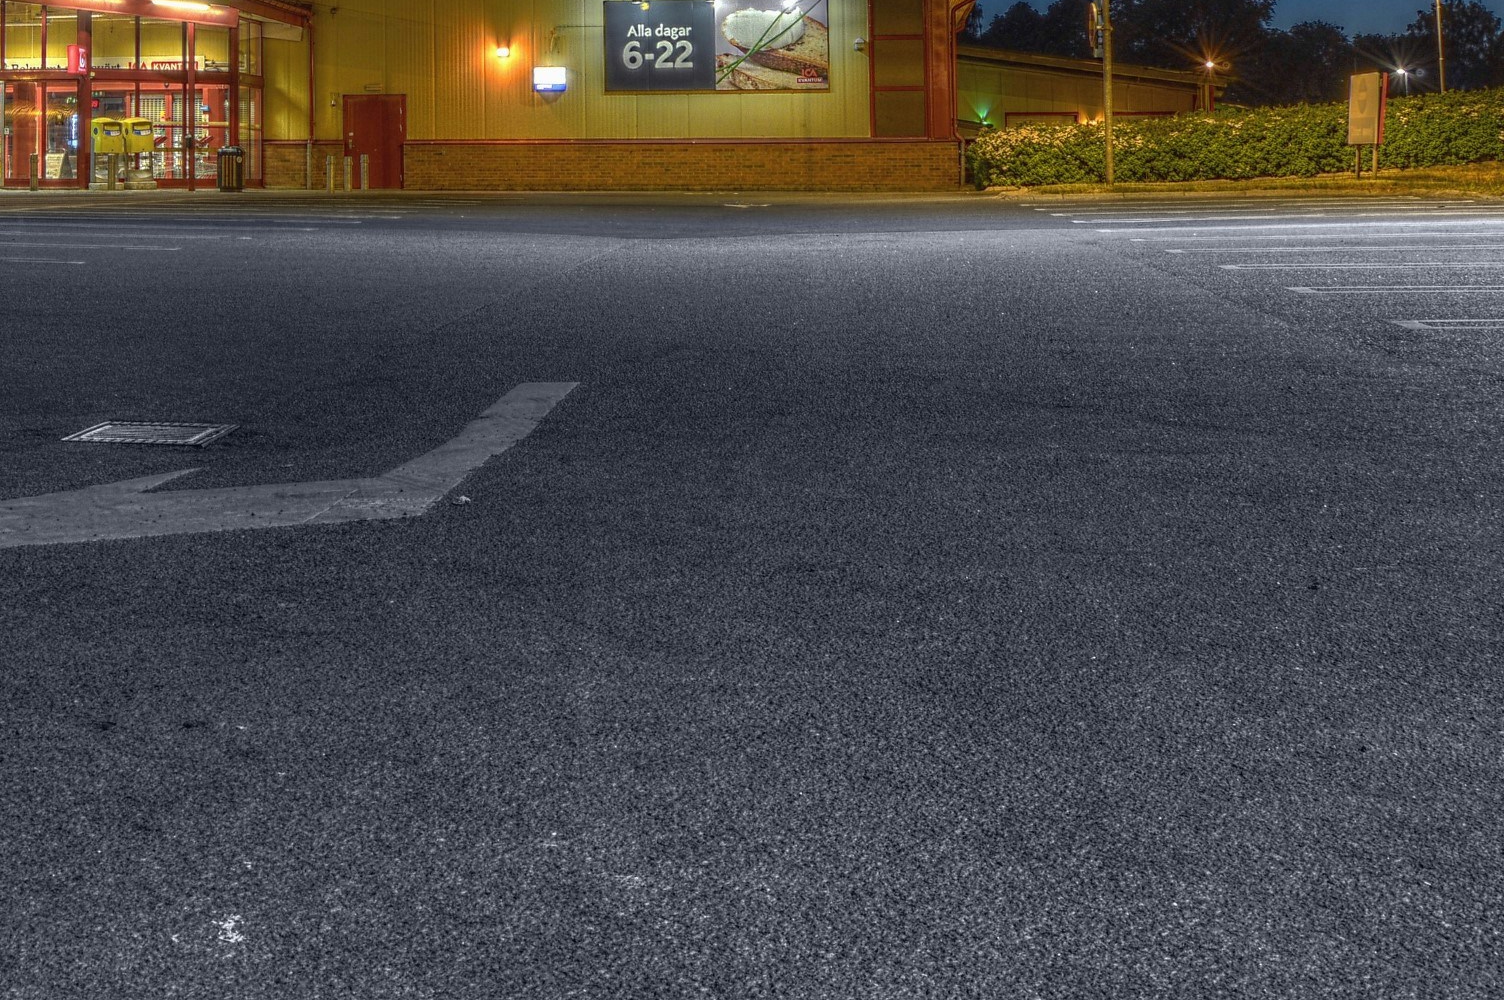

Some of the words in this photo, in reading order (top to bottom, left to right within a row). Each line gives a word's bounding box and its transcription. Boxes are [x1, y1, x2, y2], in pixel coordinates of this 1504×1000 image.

[627, 24, 652, 37] Alla
[655, 24, 692, 39] dagar
[622, 40, 694, 69] 6-22
[801, 68, 818, 77] ICA
